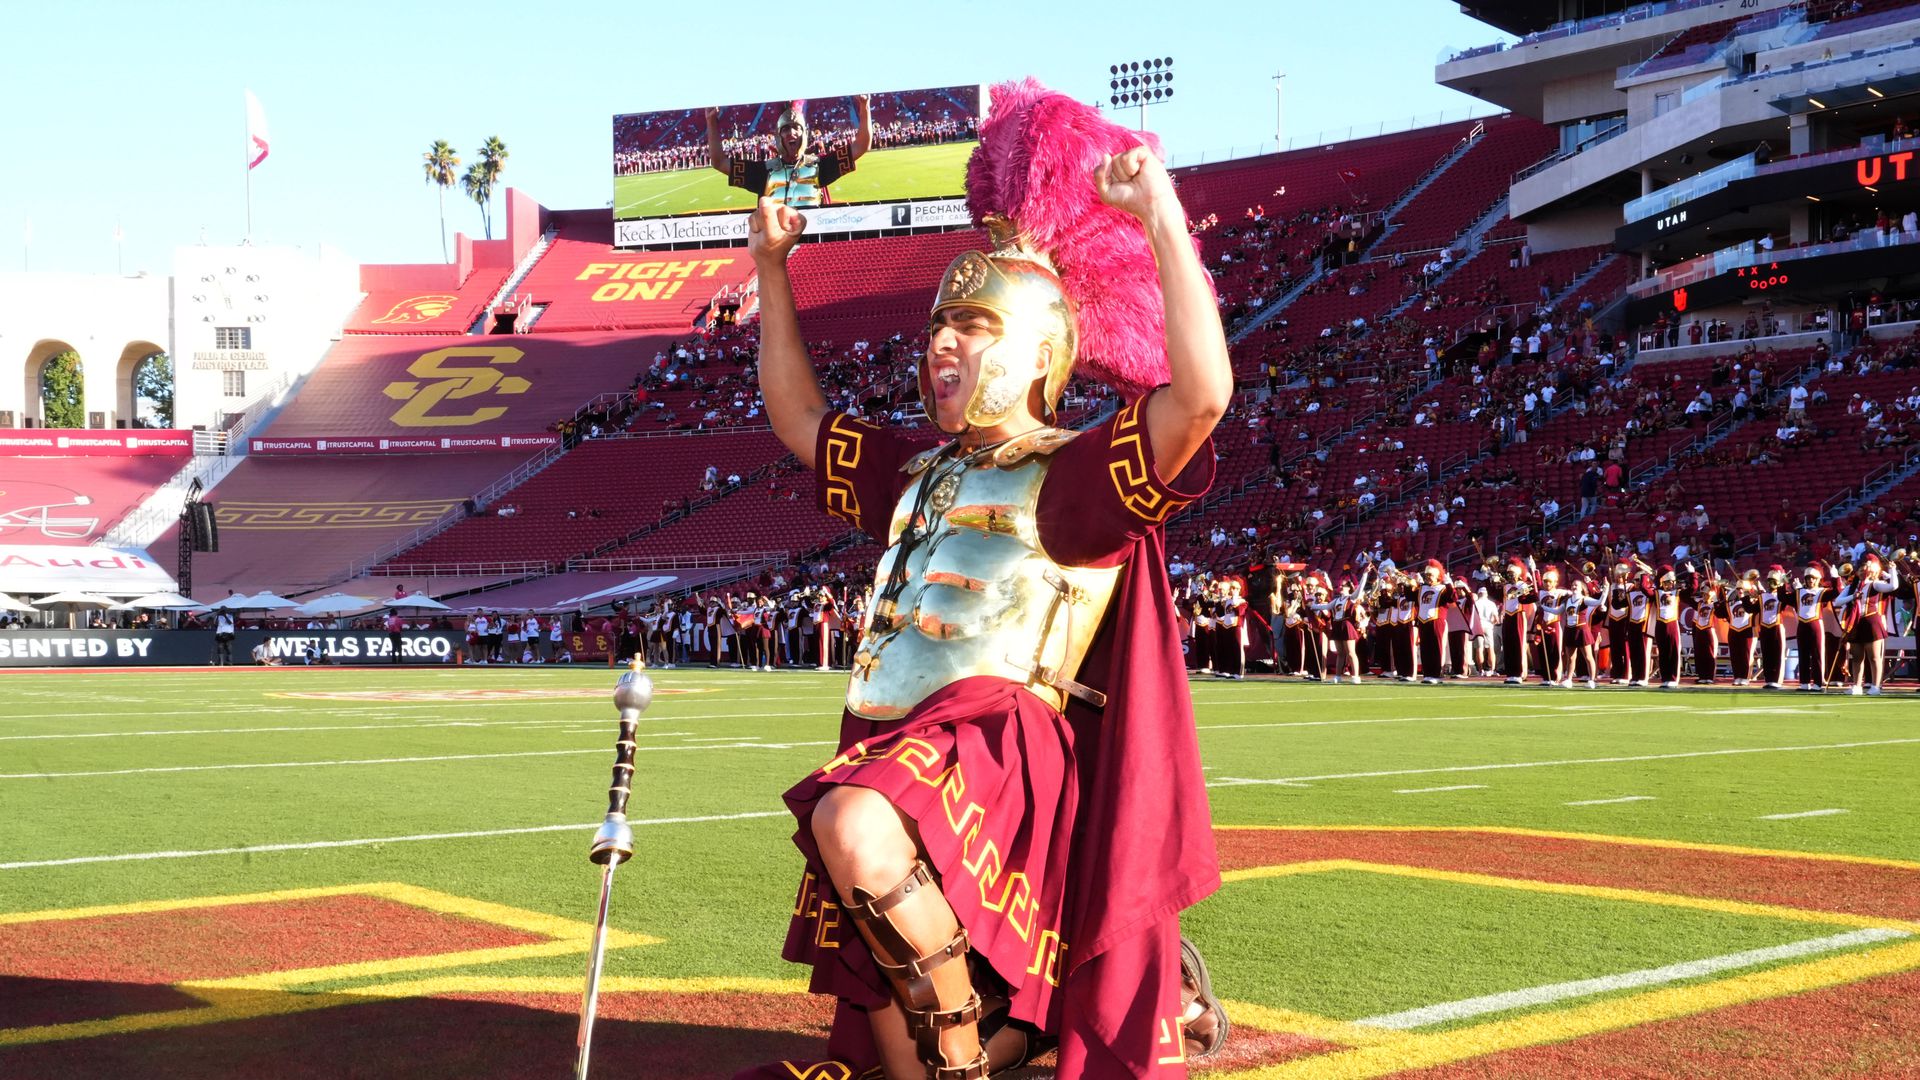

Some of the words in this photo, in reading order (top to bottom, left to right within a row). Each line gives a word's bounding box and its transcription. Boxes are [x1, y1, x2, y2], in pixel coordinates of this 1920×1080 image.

[915, 203, 969, 215] PECHANG
[915, 214, 944, 222] RESORT
[948, 212, 971, 220] CASI
[618, 223, 656, 242] Keck
[662, 221, 729, 240] Medicine
[732, 218, 748, 234] of
[816, 214, 863, 226] SmartStop
[1657, 210, 1687, 231] UTAH
[575, 258, 735, 281] FIGHT
[591, 281, 684, 302] ON!
[0, 555, 146, 569] Audi
[0, 638, 109, 658] SENTED
[116, 638, 152, 657] BY
[364, 636, 451, 657] FARGO
